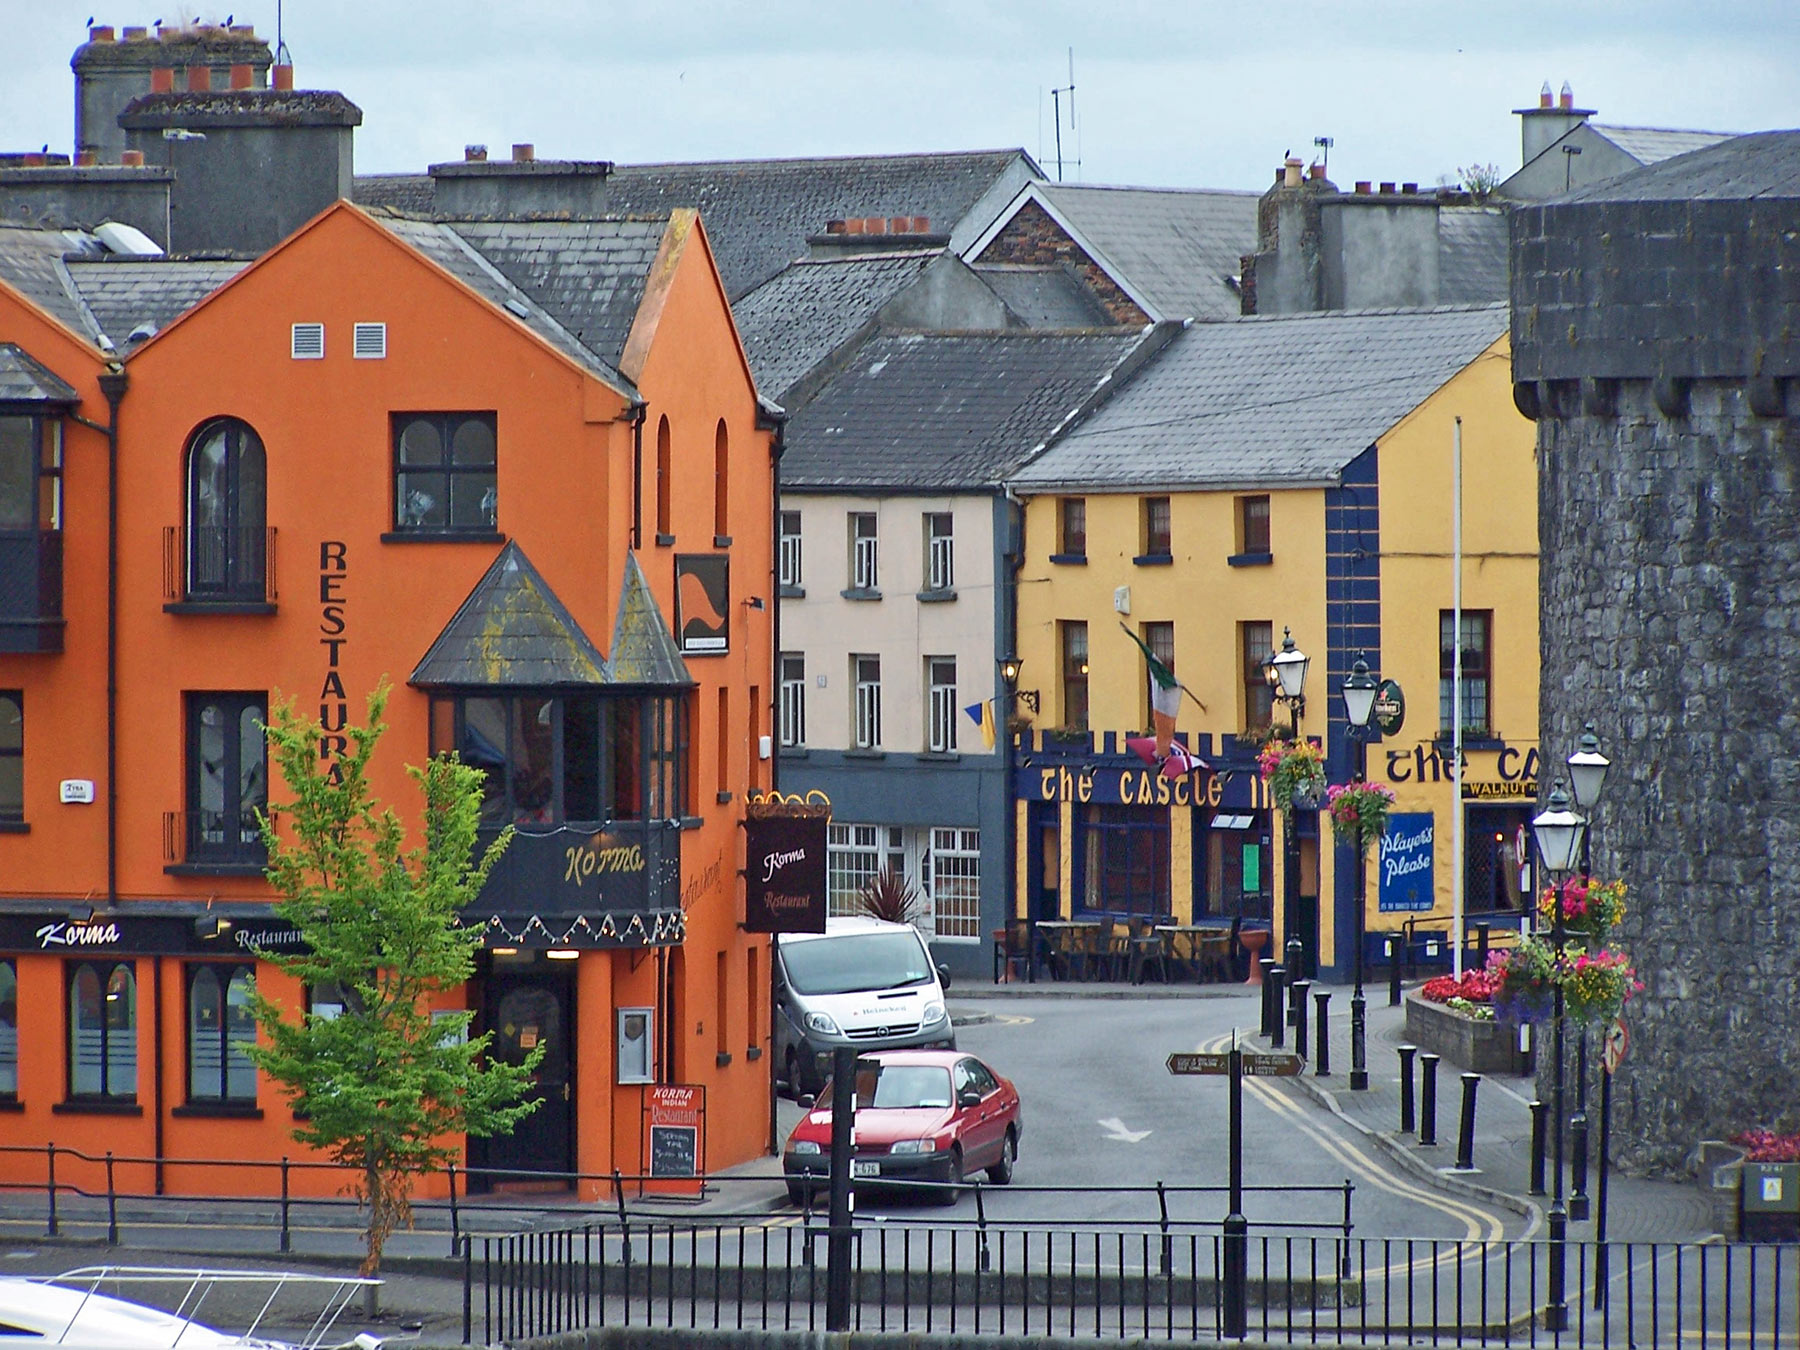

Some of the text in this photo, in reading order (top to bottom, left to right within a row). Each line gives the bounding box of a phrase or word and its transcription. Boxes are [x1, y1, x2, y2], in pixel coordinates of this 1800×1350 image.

[320, 541, 348, 790] RESTAURA
[1497, 747, 1540, 781] CA
[1469, 782, 1527, 795] WALNUT
[564, 844, 645, 887] Korma
[761, 848, 806, 882] Korma
[1385, 853, 1430, 887] Please
[764, 891, 810, 916] Restaurant
[36, 921, 120, 949] Korma
[234, 928, 306, 948] Restauran
[862, 1005, 907, 1015] Heineken
[653, 1088, 693, 1100] KORMA
[661, 1099, 688, 1107] INDIAN
[652, 1104, 697, 1124] Restaurant
